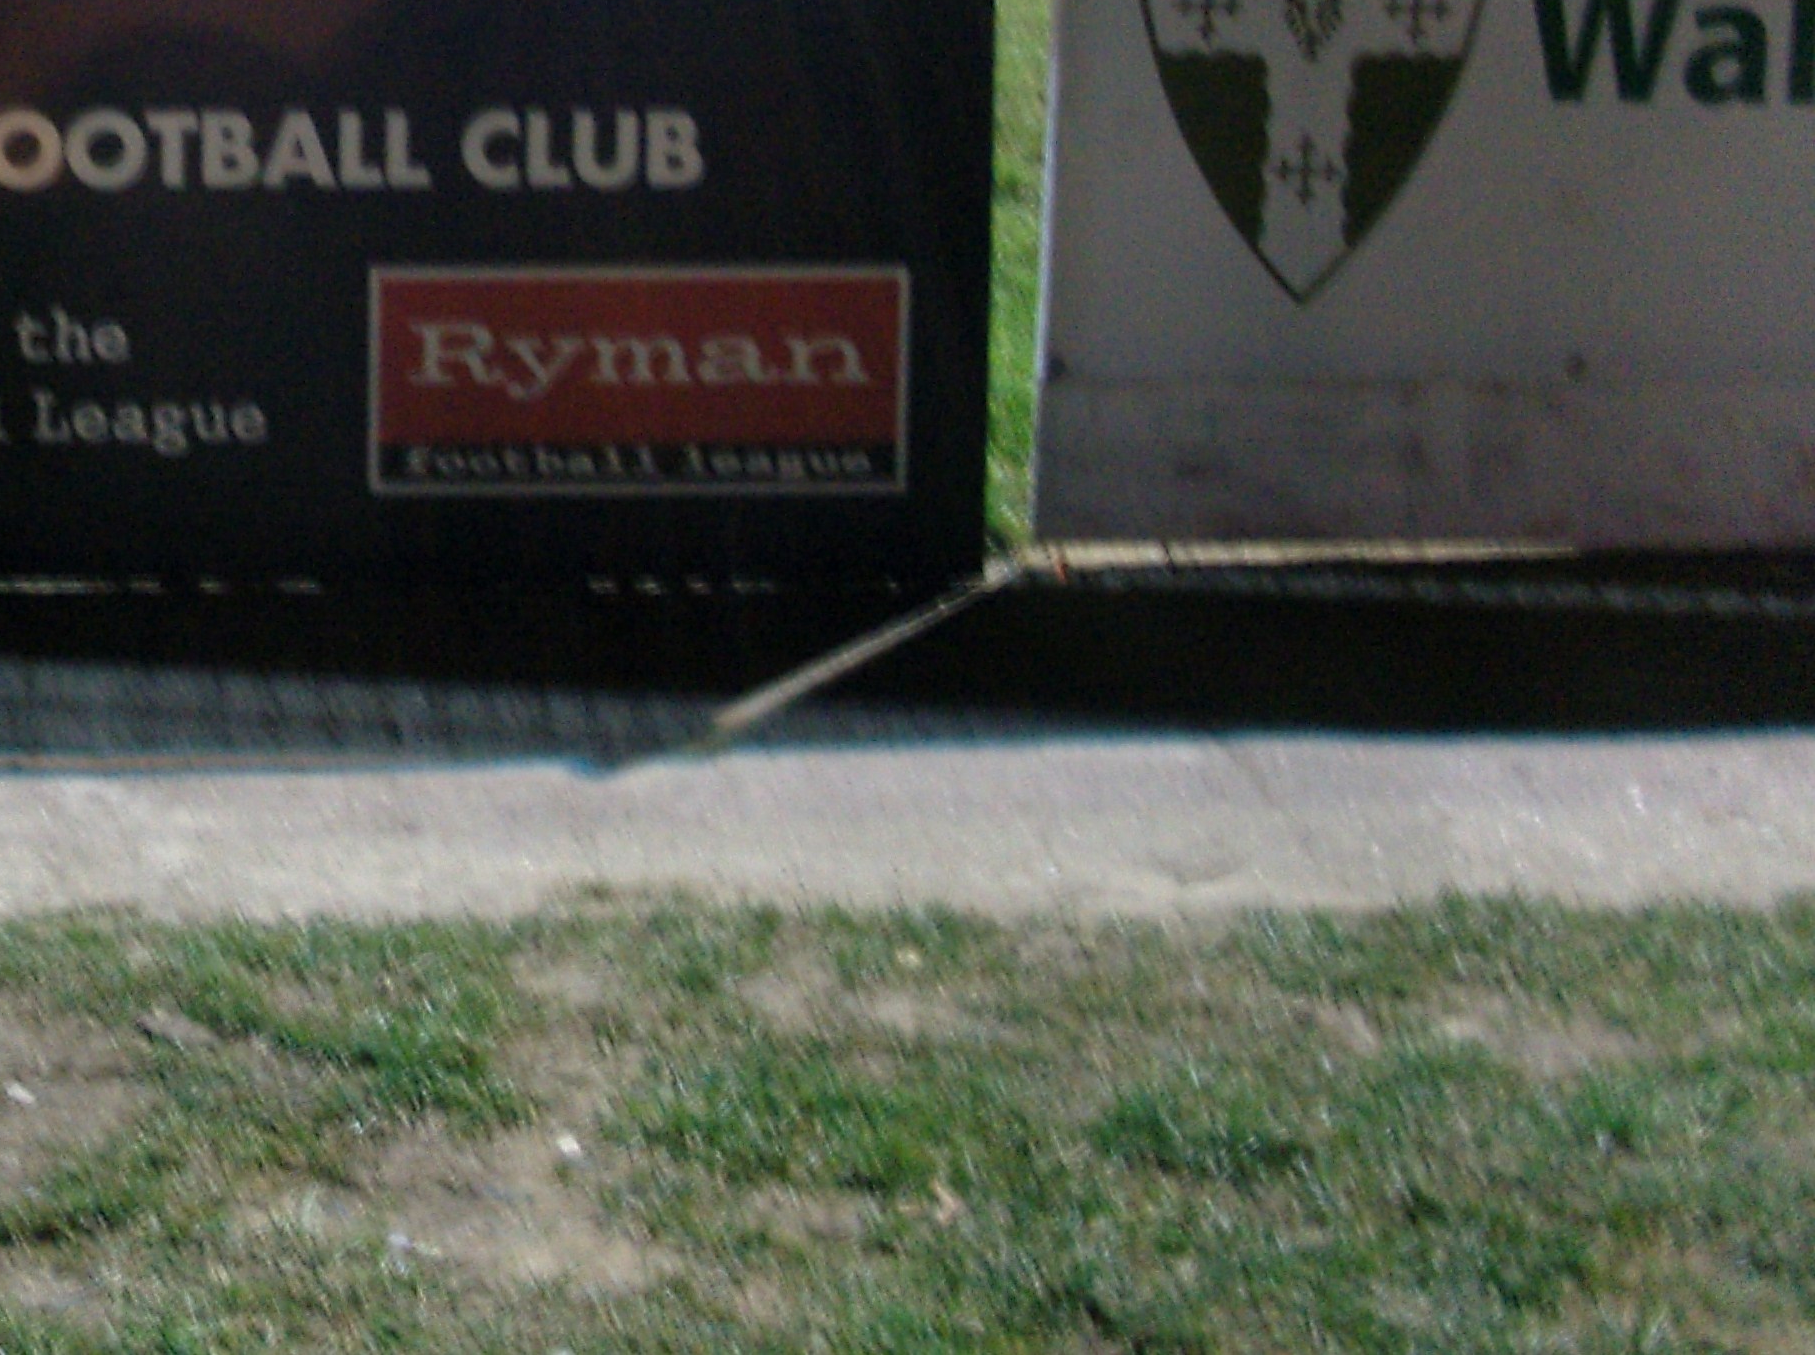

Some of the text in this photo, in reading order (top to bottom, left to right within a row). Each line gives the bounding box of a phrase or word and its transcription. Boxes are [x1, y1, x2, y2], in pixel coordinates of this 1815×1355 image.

[461, 107, 706, 190] CLUB
[15, 309, 130, 365] the
[406, 319, 871, 401] Ryman
[33, 387, 268, 457] League
